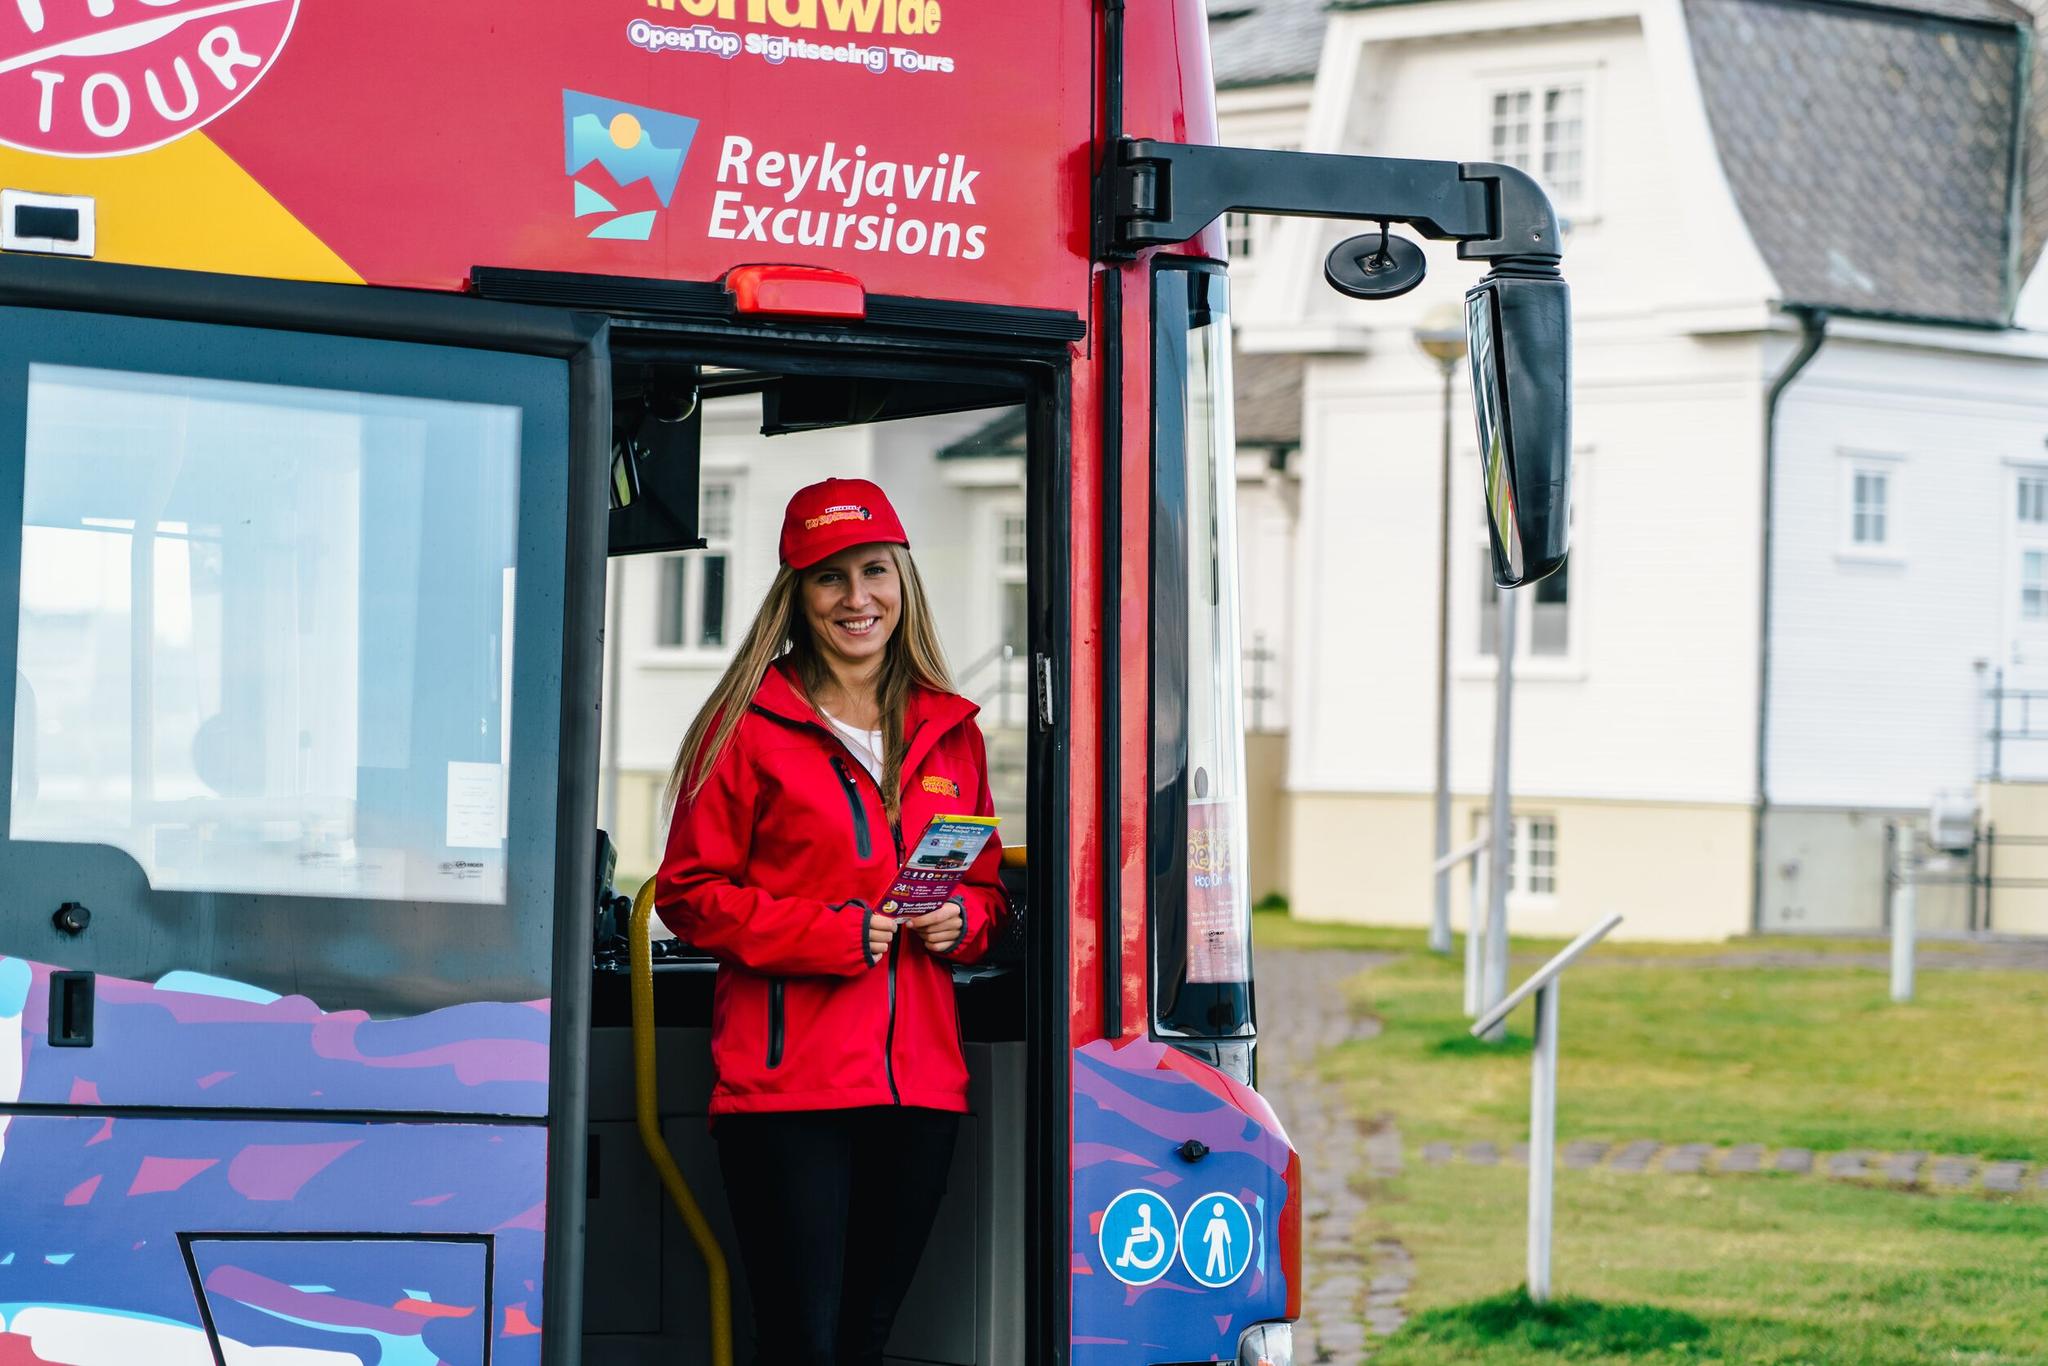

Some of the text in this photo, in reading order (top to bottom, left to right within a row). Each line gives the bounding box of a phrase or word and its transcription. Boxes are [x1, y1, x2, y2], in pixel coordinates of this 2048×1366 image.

[647, 0, 941, 34] dwide
[31, 26, 261, 137] TOUR
[744, 33, 884, 70] Sightseeing
[888, 47, 955, 73] Tours
[716, 135, 981, 207] Reykjavik
[708, 190, 987, 260] Excursions
